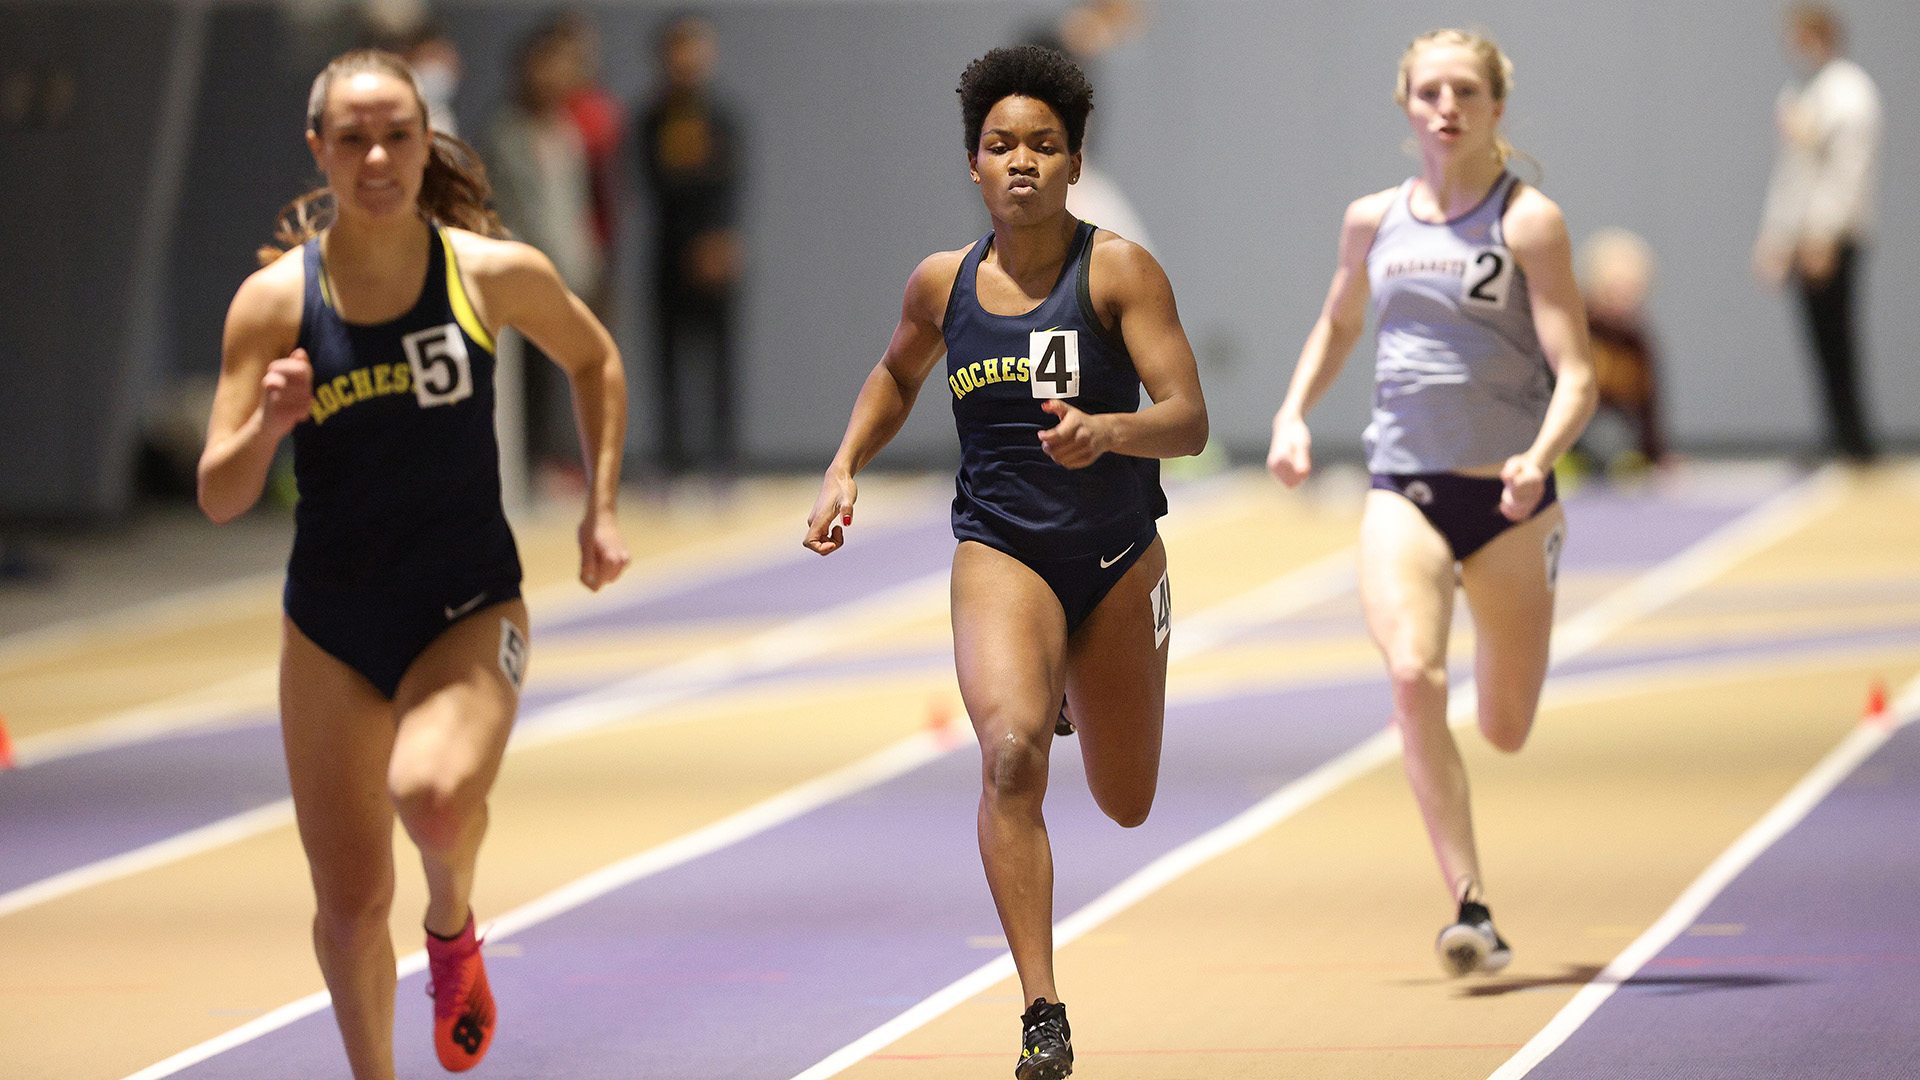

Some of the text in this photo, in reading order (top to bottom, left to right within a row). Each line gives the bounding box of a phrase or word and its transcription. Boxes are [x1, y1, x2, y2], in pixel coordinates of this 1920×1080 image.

[1469, 252, 1503, 302] 2
[311, 362, 416, 425] ROCHES
[416, 333, 459, 395] 5
[1035, 335, 1073, 394] 4
[504, 629, 524, 687] 5
